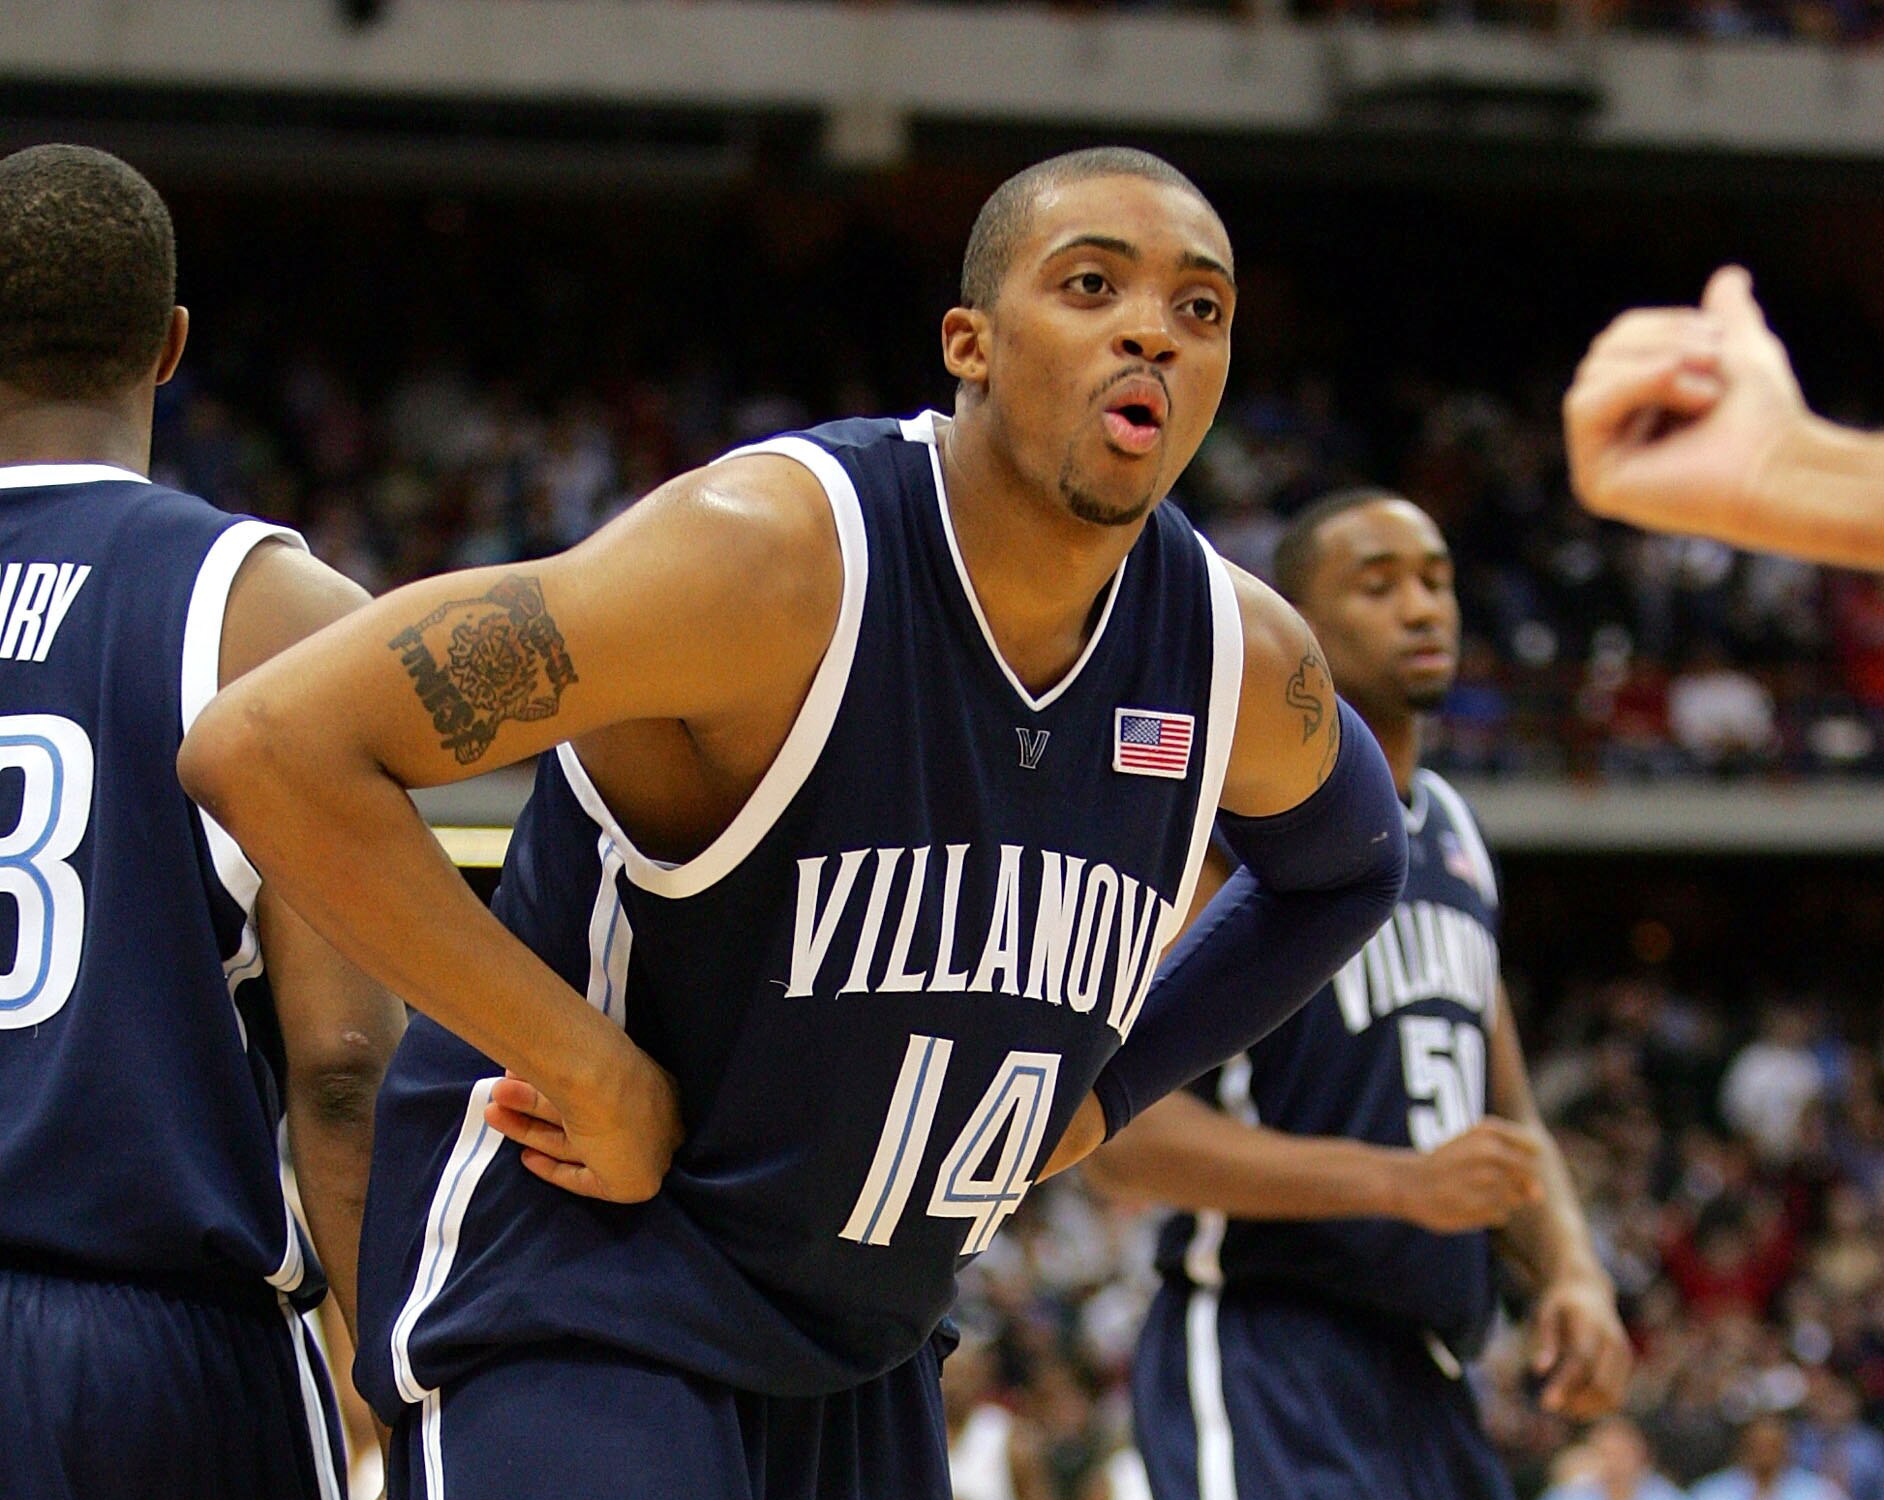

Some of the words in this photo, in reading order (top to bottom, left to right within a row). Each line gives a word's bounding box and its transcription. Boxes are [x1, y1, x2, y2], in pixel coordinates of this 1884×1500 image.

[1015, 727, 1050, 768] V
[838, 1034, 1061, 1256] 14
[1398, 1014, 1486, 1154] 50
